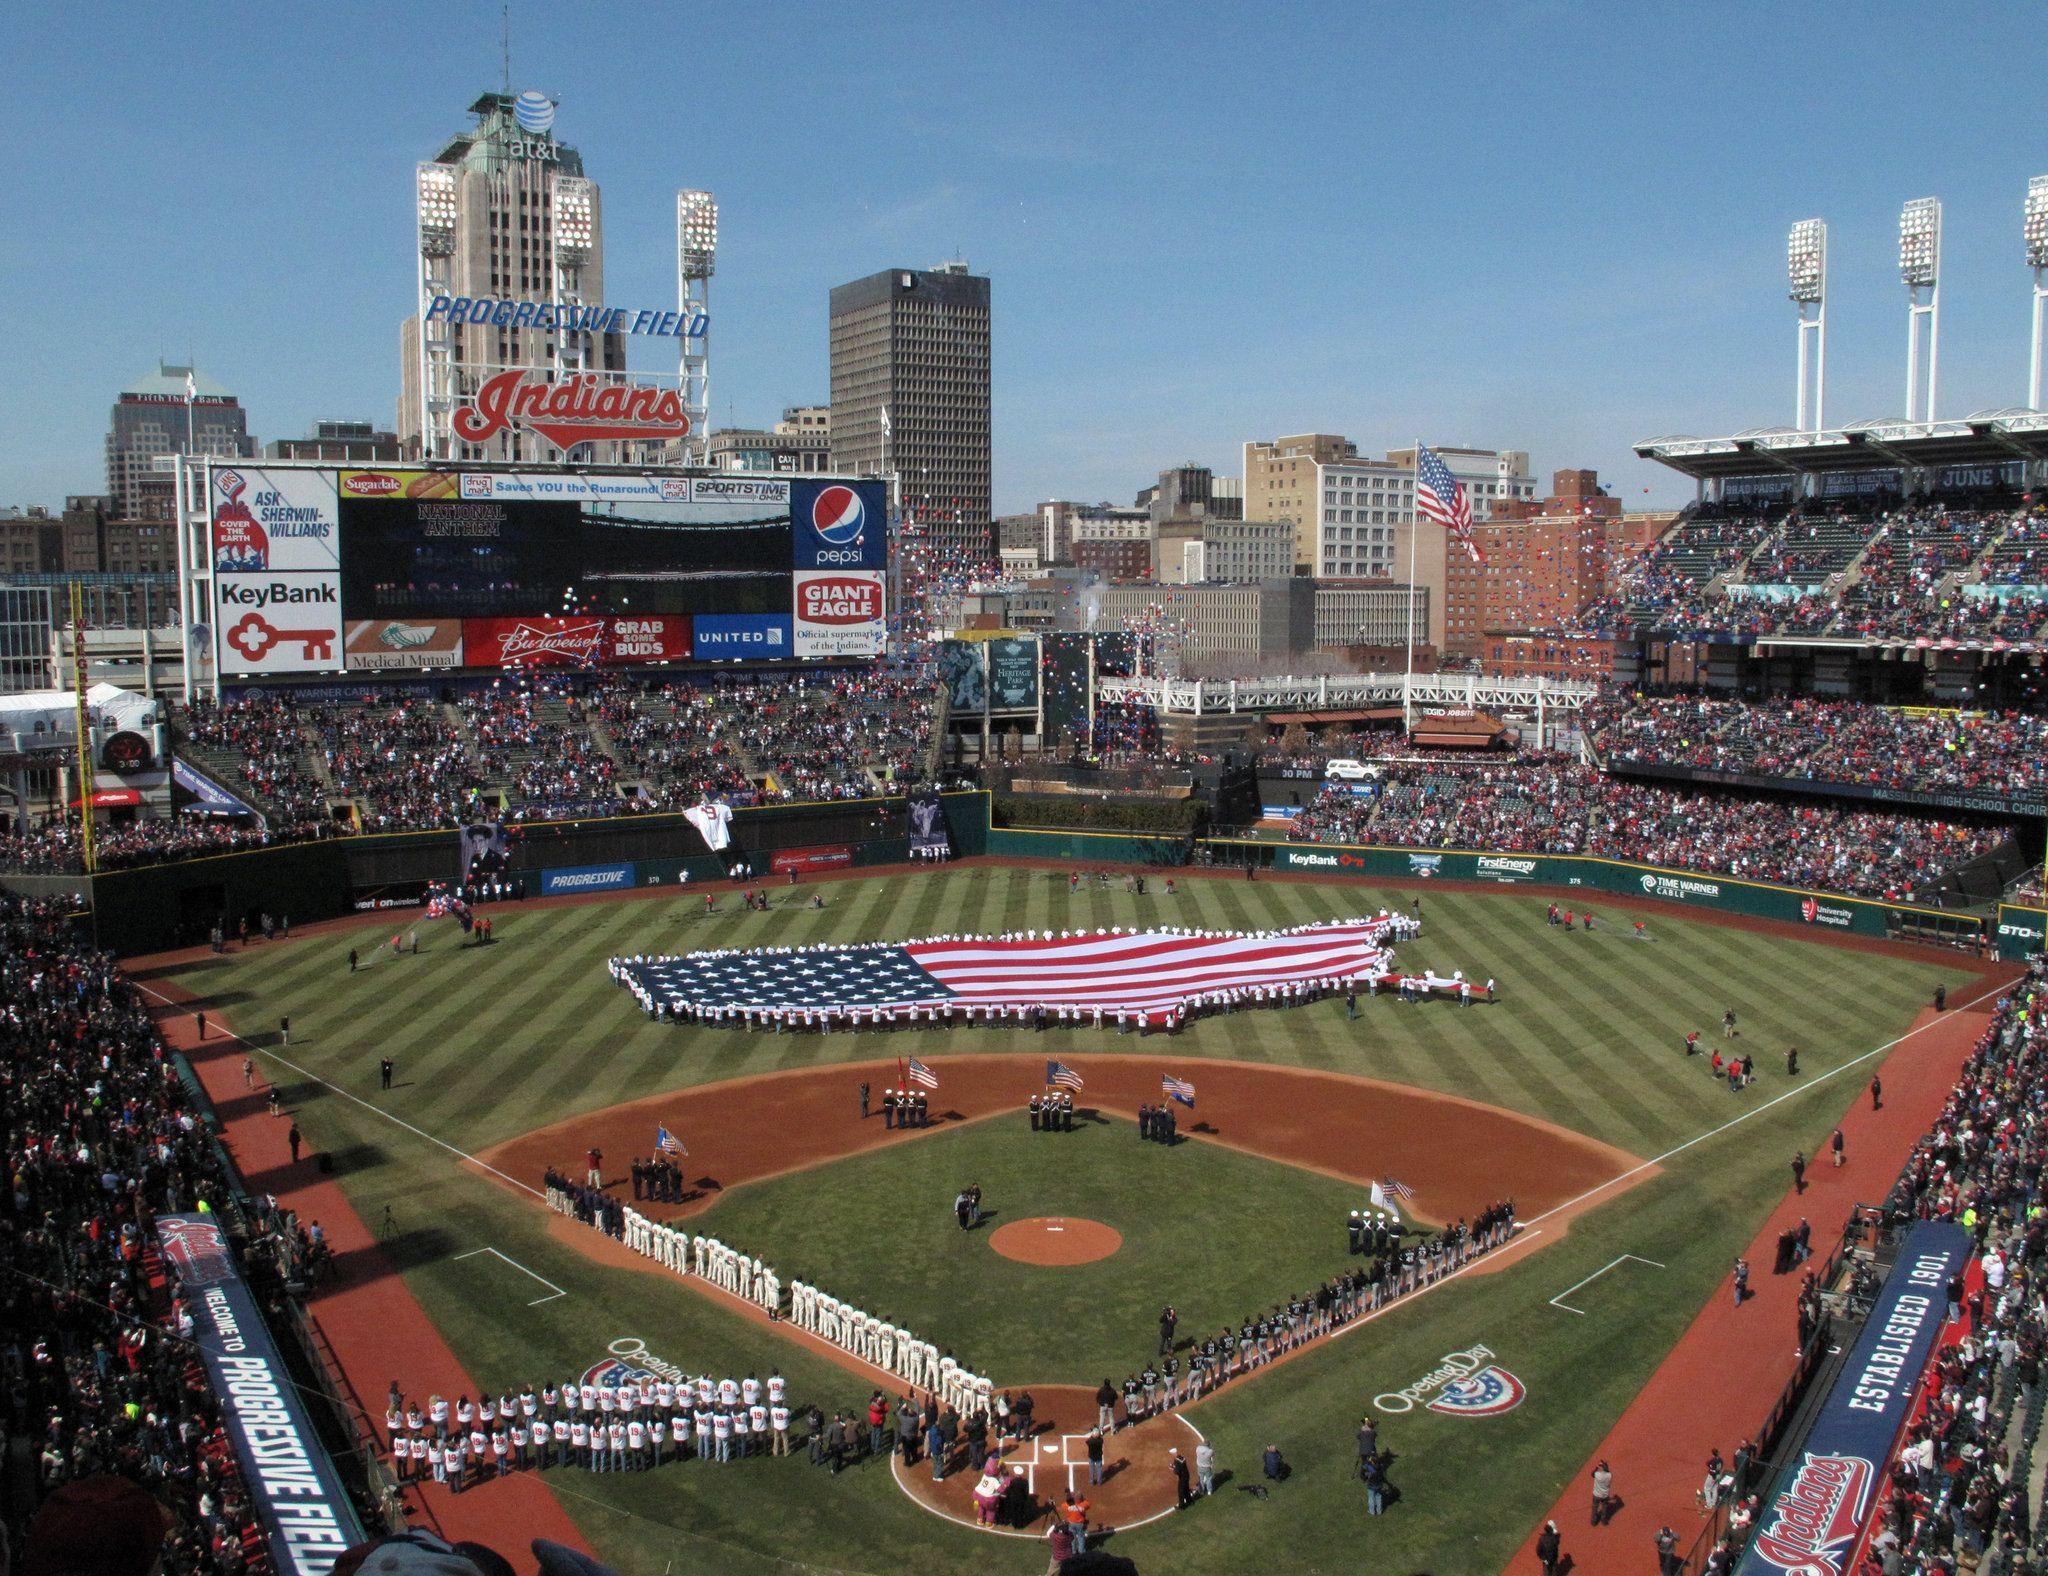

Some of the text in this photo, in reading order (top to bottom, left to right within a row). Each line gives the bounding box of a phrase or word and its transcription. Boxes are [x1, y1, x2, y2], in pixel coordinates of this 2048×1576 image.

[509, 138, 560, 161] at&t
[425, 296, 711, 338] PROGRESSIVE FIELD
[199, 396, 225, 404] Bank
[453, 369, 691, 445] Indians
[347, 476, 401, 492] Sugardale
[466, 476, 487, 488] drug
[1943, 469, 1993, 487] JUNE
[496, 482, 533, 493] Saves
[536, 482, 563, 493] YOU
[566, 483, 586, 493] the
[664, 482, 684, 493] drug
[254, 492, 280, 507] ASK
[261, 507, 324, 523] SHERWIN-
[418, 504, 507, 520] NATIONAL
[220, 520, 250, 528] COVER
[226, 527, 244, 535] THE
[269, 523, 331, 538] WILLIAMS
[425, 521, 501, 536] ANTHEM
[221, 534, 251, 542] EARTH
[816, 547, 863, 566] pepsi
[221, 582, 337, 608] KeyBank
[804, 585, 873, 601] GIANT
[806, 601, 873, 617] EAGLE
[614, 621, 664, 635] GRAB
[497, 631, 602, 652] Budweiser
[622, 633, 656, 643] SOME
[700, 631, 763, 643] UNITED
[615, 642, 664, 655] BUDS
[811, 641, 820, 650] of
[821, 641, 835, 650] the
[353, 652, 456, 669] Medical Mutual
[1297, 770, 1312, 778] PM
[1873, 789, 2048, 816] MASSILLON HIGH SCHOOL CHOIR
[1289, 853, 1338, 867] KeyBank
[1477, 856, 1536, 871] FirstEnergy
[550, 870, 627, 888] PROGRESSIVE
[1568, 877, 1581, 885] 375
[1657, 877, 1719, 895] TIME WARNER
[1656, 888, 1685, 899] CABLE
[1816, 905, 1853, 919] University
[1816, 914, 1850, 926] Hospitals
[203, 1285, 247, 1352] WELCOME TO
[1848, 1294, 1932, 1413] ESTABLISHED
[659, 1388, 666, 1396] 19
[700, 1384, 708, 1392] 19
[724, 1384, 731, 1392] 19
[745, 1384, 752, 1392] 19
[602, 1392, 610, 1400] 19
[622, 1392, 628, 1400] 19
[754, 1412, 762, 1420] 19
[775, 1412, 784, 1420] 19
[217, 1356, 325, 1497] PROGRESSIVE
[716, 1420, 724, 1428] 19
[448, 1454, 456, 1462] 19
